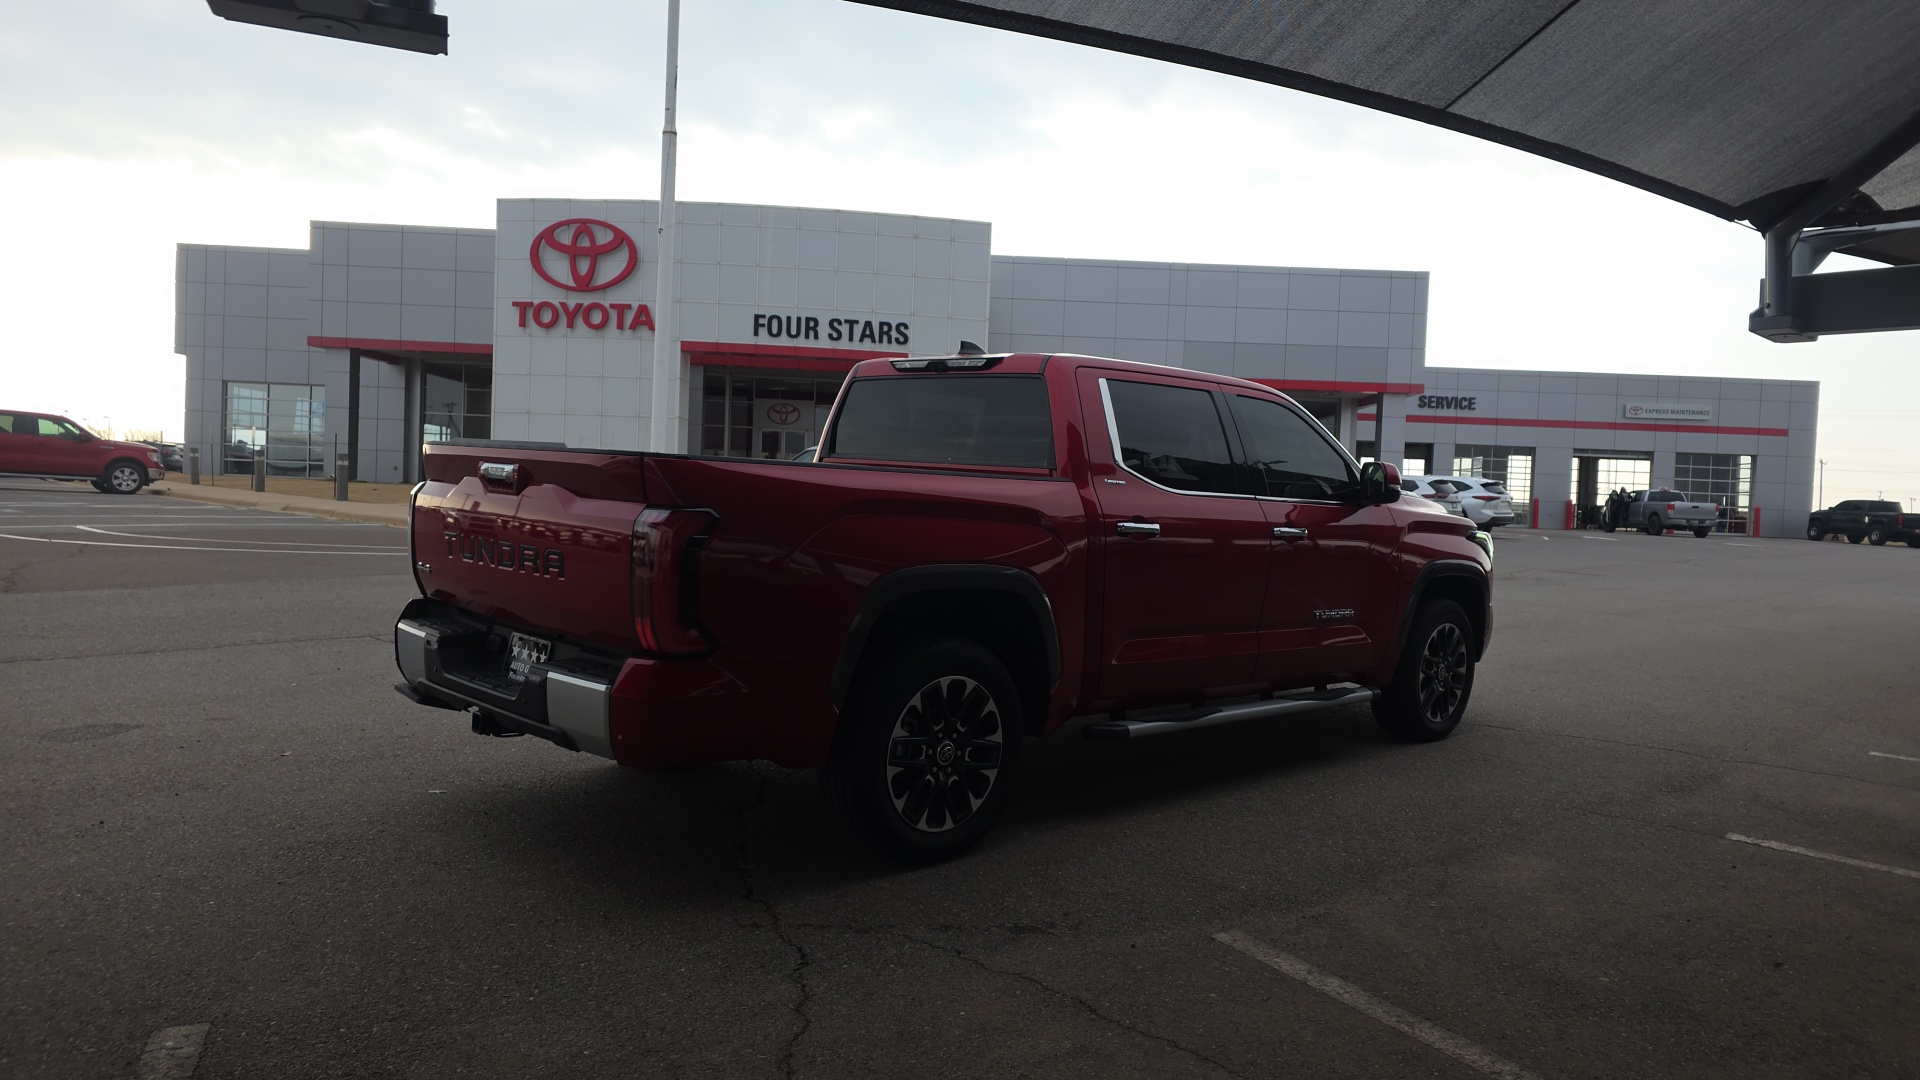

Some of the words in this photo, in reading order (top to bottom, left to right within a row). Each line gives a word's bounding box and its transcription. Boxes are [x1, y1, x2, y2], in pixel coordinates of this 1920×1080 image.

[512, 301, 655, 331] TOYOTA
[753, 313, 820, 340] FOUR
[827, 318, 910, 345] STARS
[1418, 395, 1476, 411] SERVICE
[444, 531, 565, 580] TUNDRA
[1313, 608, 1355, 619] TUNDRA
[510, 661, 524, 672] AUTO
